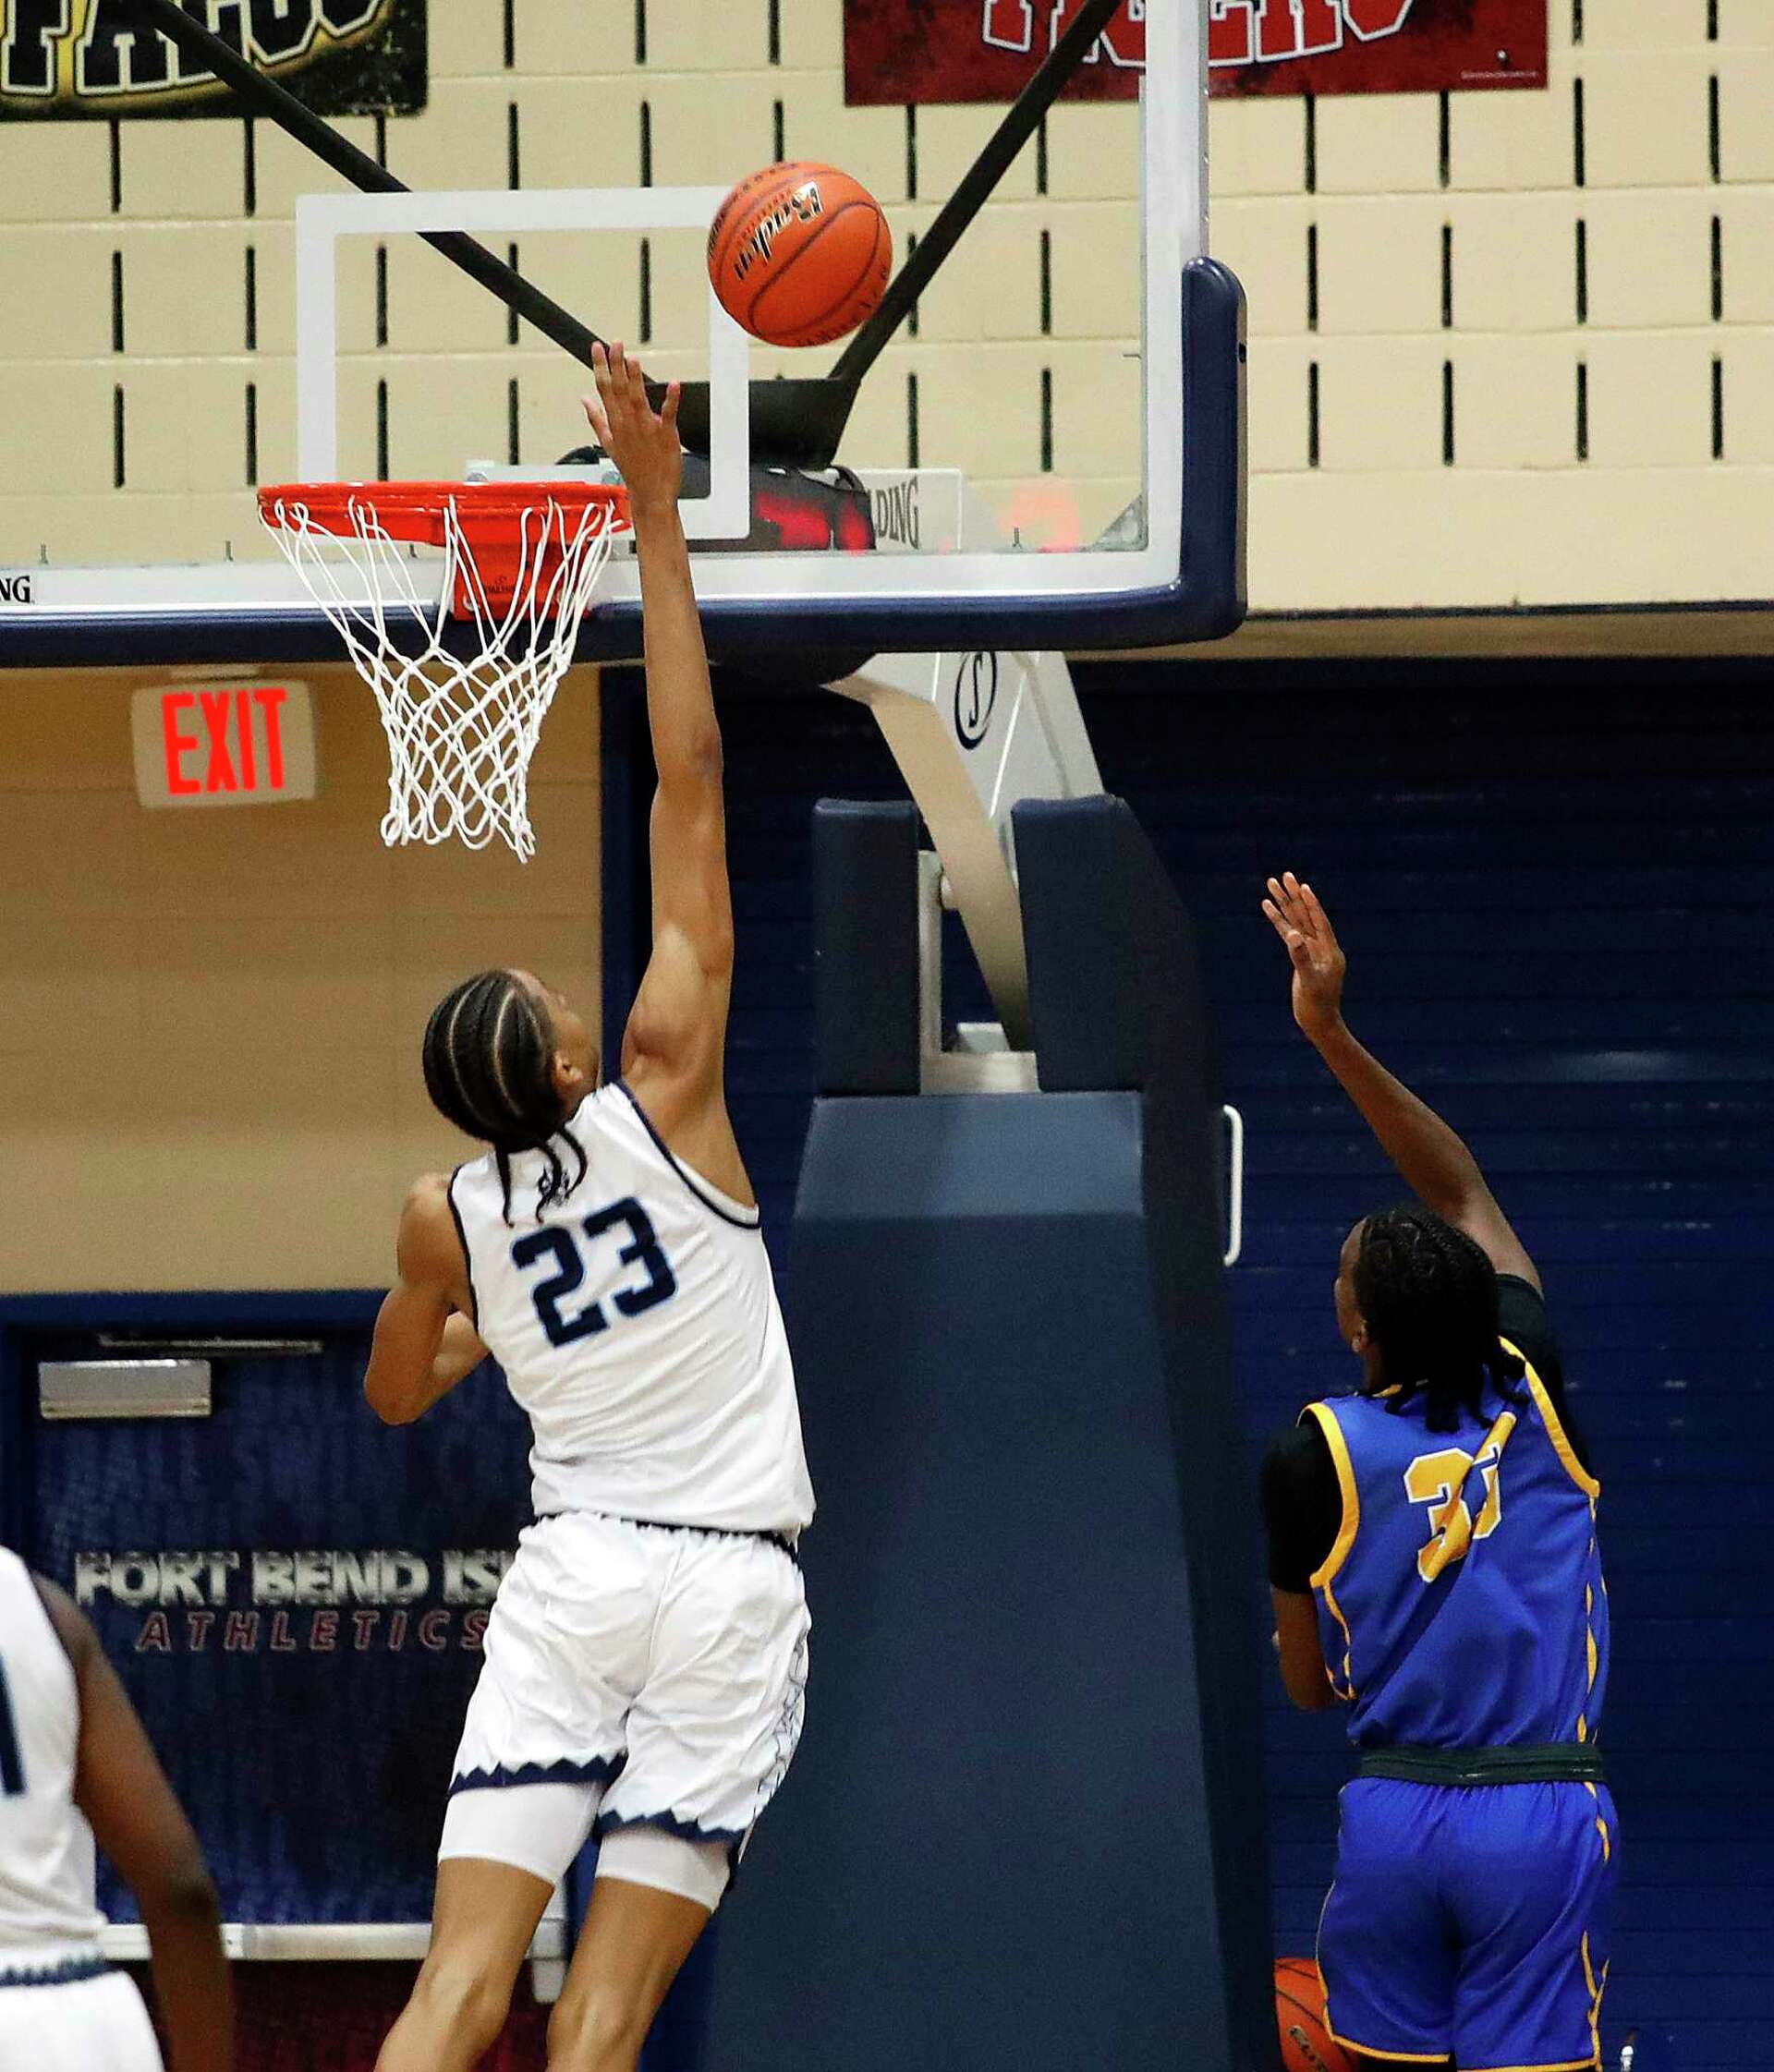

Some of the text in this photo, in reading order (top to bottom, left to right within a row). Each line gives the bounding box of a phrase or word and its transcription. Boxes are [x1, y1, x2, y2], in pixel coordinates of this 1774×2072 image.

[867, 472, 919, 550] DING
[162, 687, 288, 796] EXIT
[512, 1197, 676, 1348] 23
[74, 1551, 240, 1605] FORT
[251, 1550, 429, 1605] BEND
[134, 1609, 489, 1653] ATHLETICS
